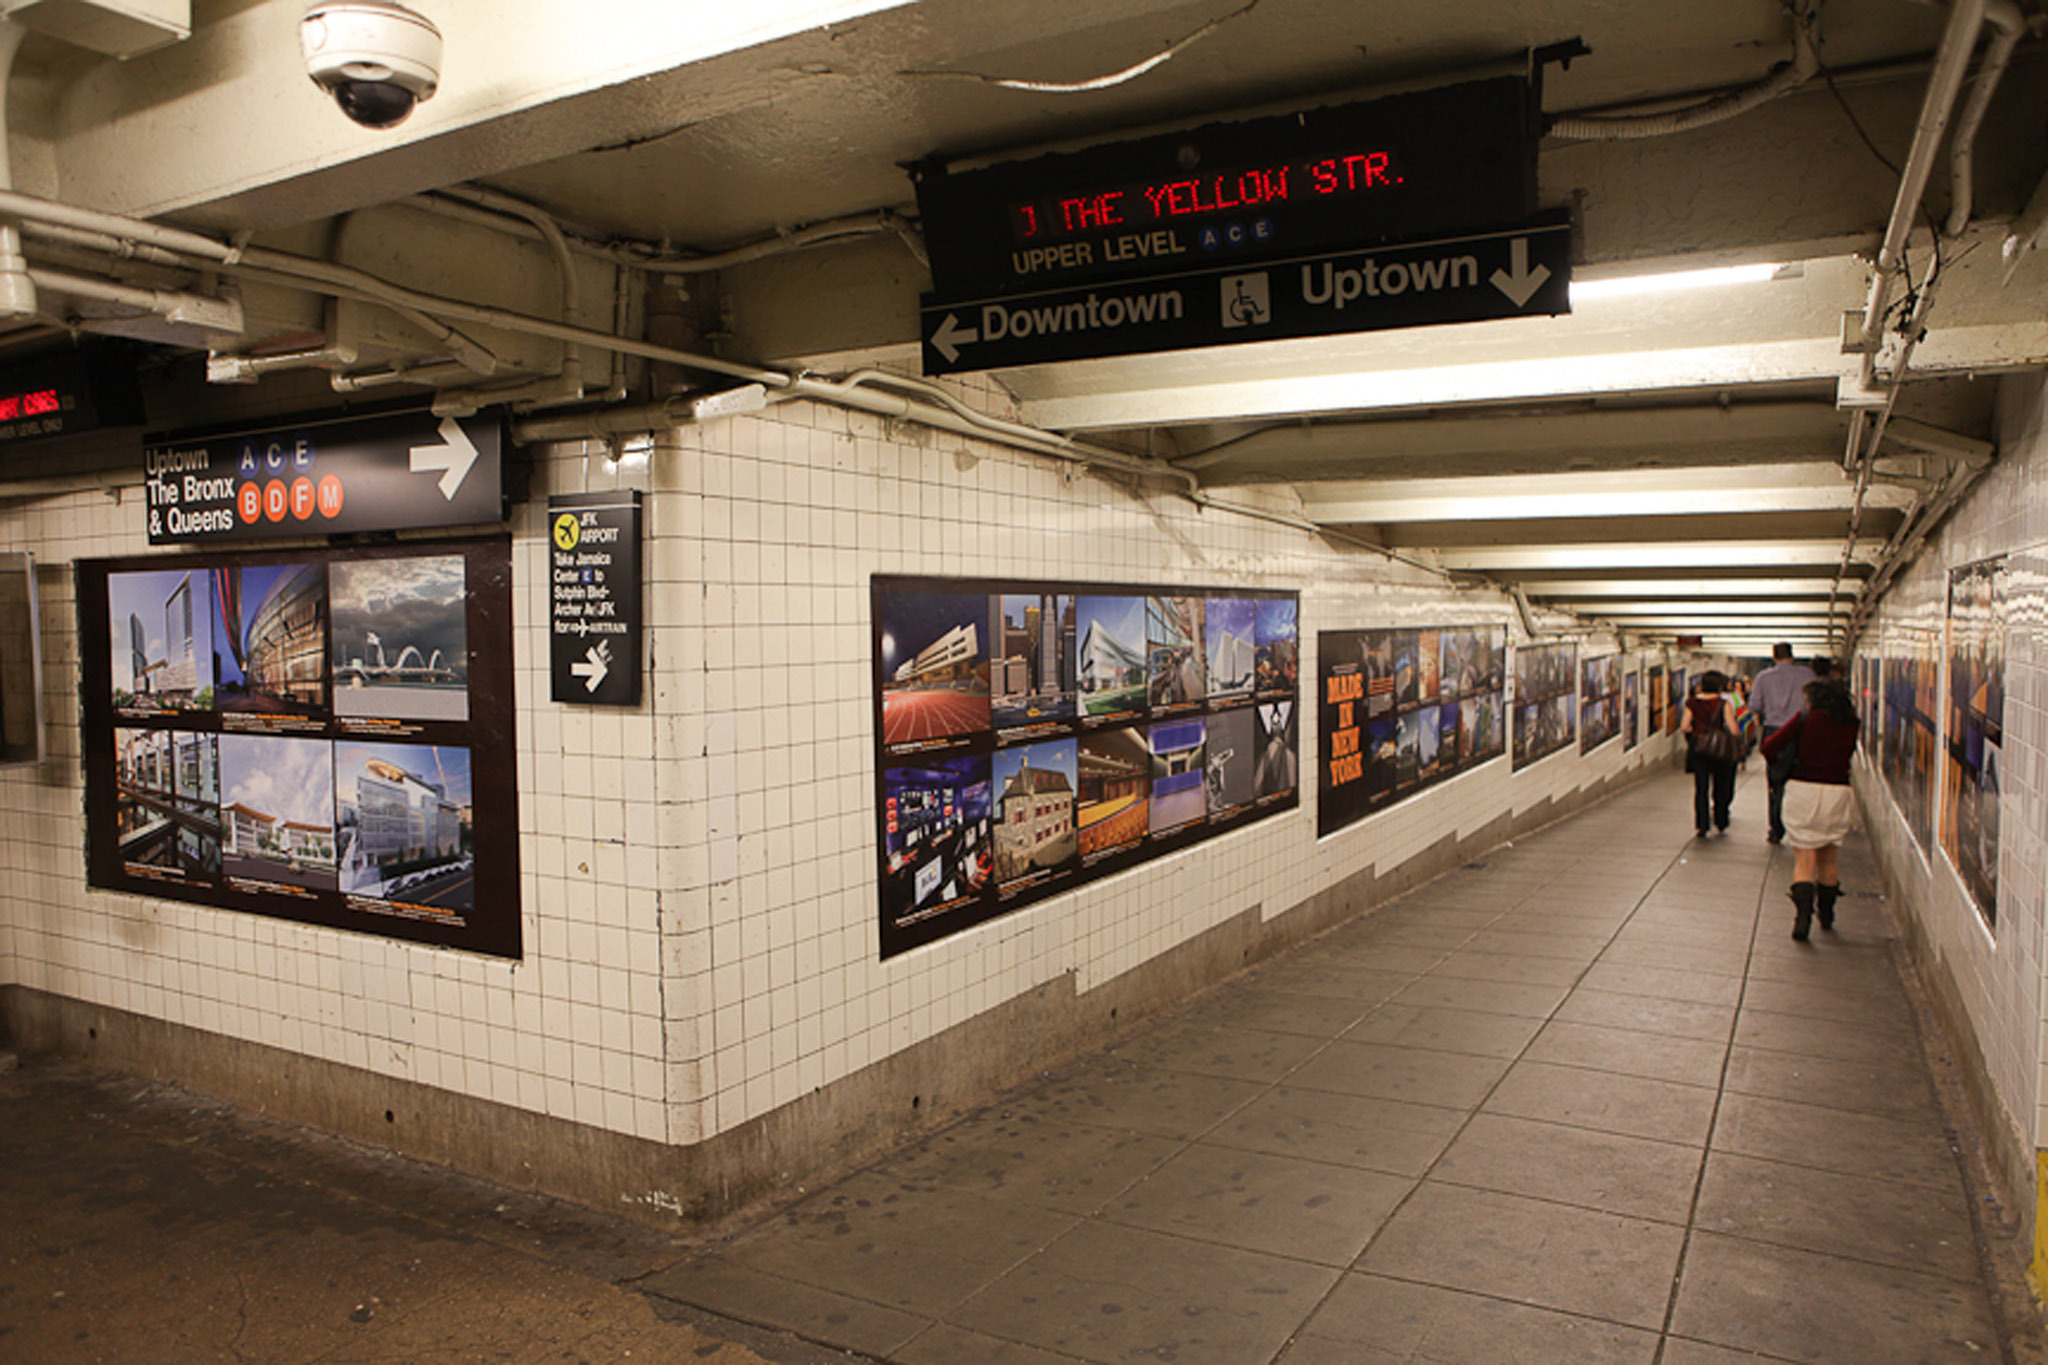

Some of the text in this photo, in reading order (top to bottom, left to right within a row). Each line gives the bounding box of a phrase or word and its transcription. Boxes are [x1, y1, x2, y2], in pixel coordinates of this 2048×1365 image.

[1059, 191, 1124, 231] THE
[1144, 165, 1290, 217] YELLOW
[1312, 151, 1404, 194] STR.
[1012, 241, 1094, 274] UPPER
[1103, 230, 1187, 262] LEVEL
[982, 254, 1478, 342] Downtown Uptown
[146, 448, 210, 480] Uptown
[241, 440, 309, 470] A C E
[147, 475, 236, 506] The Bronx
[244, 485, 339, 516] B D F M
[149, 507, 235, 537] & Queens
[1329, 751, 1363, 787] YORK
